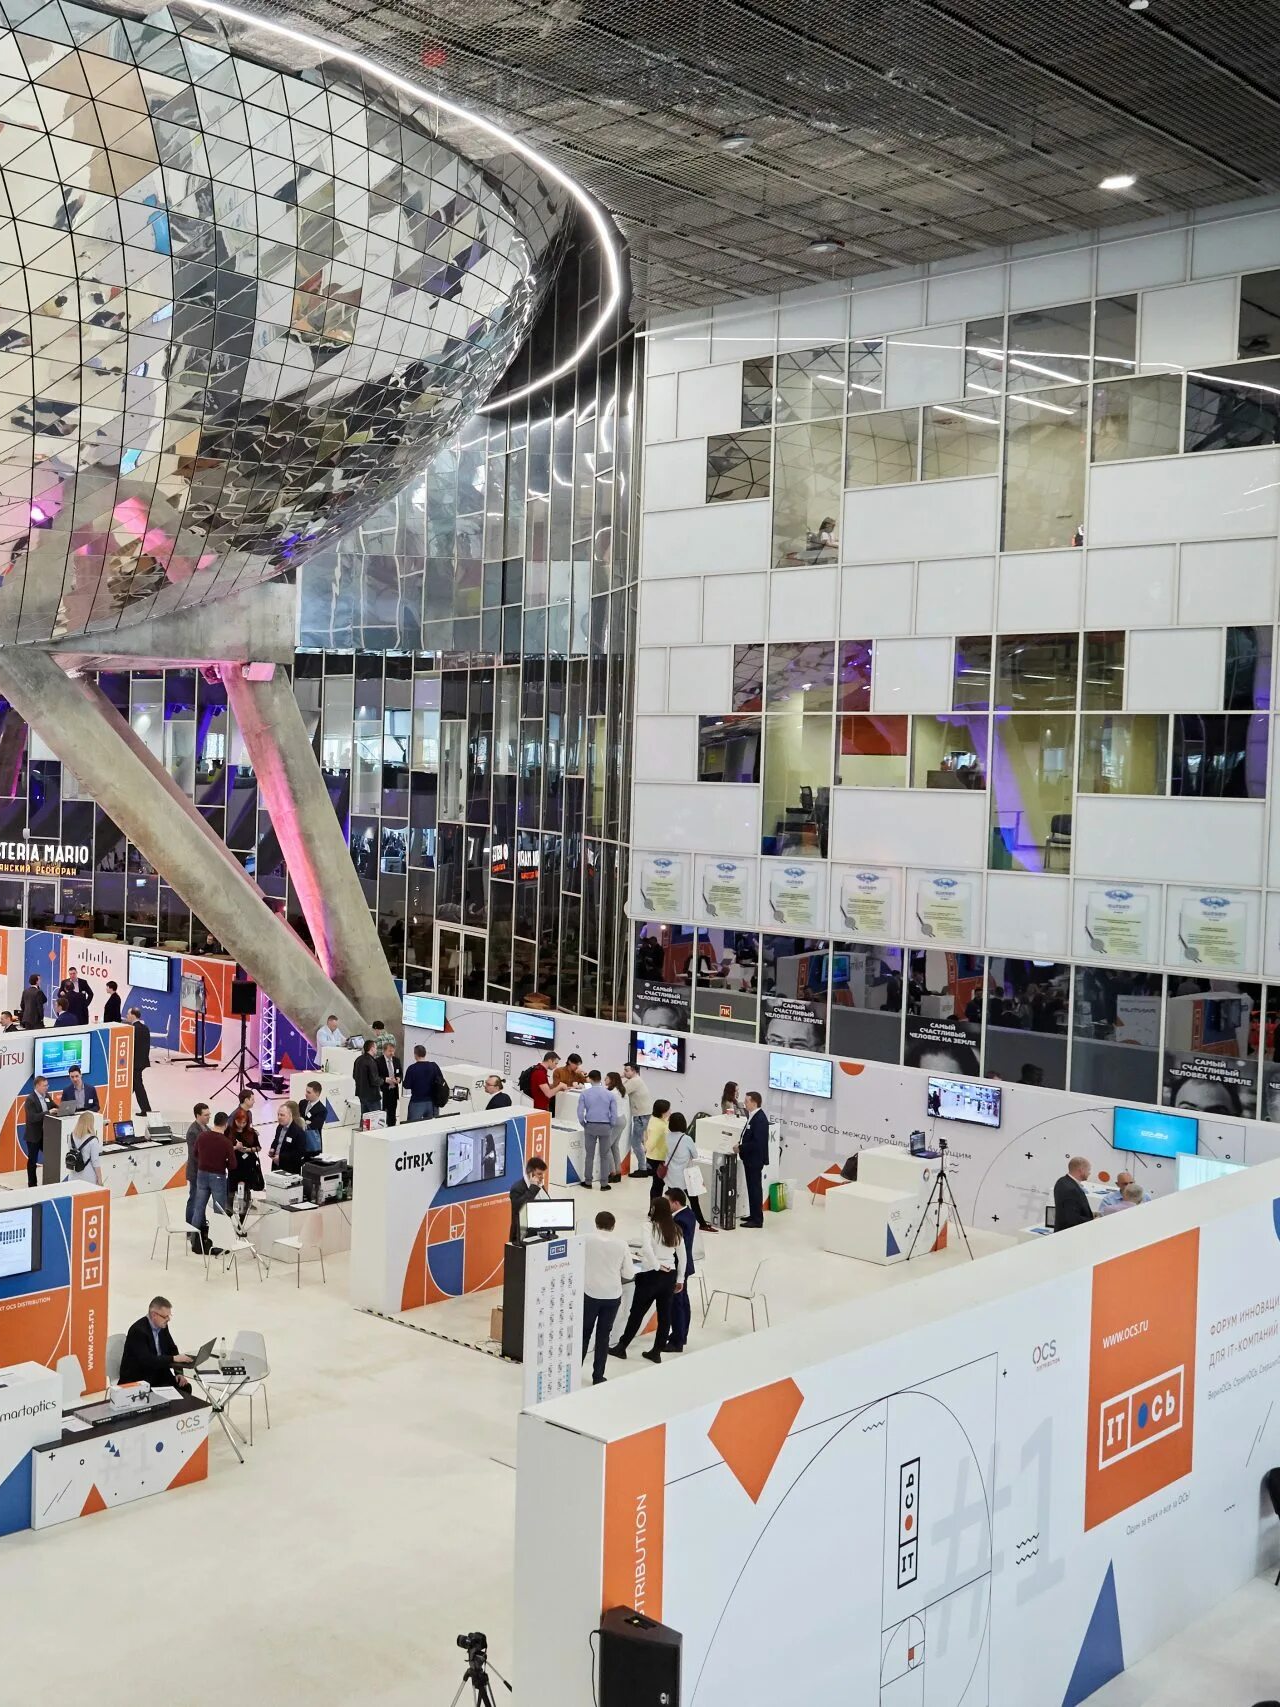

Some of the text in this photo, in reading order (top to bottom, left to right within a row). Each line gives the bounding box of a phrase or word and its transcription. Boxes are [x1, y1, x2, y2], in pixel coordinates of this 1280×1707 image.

[45, 844, 88, 864] MARIO
[36, 867, 77, 876] РЕСТОРАН
[80, 965, 108, 979] CISCO
[637, 994, 661, 1002] ЧЕЛОВЕК
[645, 990, 680, 999] СЧАСТЛИВЫЙ
[774, 1007, 815, 1018] СЧАСТЛИВЫЙ
[783, 1002, 805, 1010] САМЫЙ
[765, 1012, 792, 1021] ЧЕЛОВЕК
[803, 1017, 823, 1025] ЗЕМЛЕ
[920, 1028, 966, 1038] СЧАСТЛИВЫЙ
[930, 1022, 956, 1030] САМЫЙ
[909, 1032, 941, 1042] ЧЕЛОВЕК
[953, 1038, 976, 1046] ЗЕМЛЕ
[1195, 1058, 1226, 1068] САМЫЙ
[1170, 1069, 1252, 1086] ЧЕЛОВЕК НА ЗЕМЛЕ
[1182, 1064, 1240, 1077] СЧАСТЛИВЫЙ
[770, 1115, 787, 1125] Есть
[790, 1120, 818, 1130] только
[820, 1124, 839, 1134] ОСЬ
[842, 1130, 872, 1142] между
[874, 1136, 910, 1148] прошлы
[168, 1147, 184, 1156] OCS
[85, 1265, 99, 1280] IT
[18, 1296, 50, 1309] DISTRIBUTION
[1210, 1314, 1238, 1336] ФОРУМ
[1103, 1320, 1148, 1349] www.ocs.ru
[1032, 1339, 1056, 1365] OCS
[1209, 1320, 1279, 1372] ДЛЯ IT-КОМПАНИЙ
[176, 1415, 200, 1432] OCS
[1107, 1412, 1125, 1446] IT
[902, 1552, 914, 1573] IT
